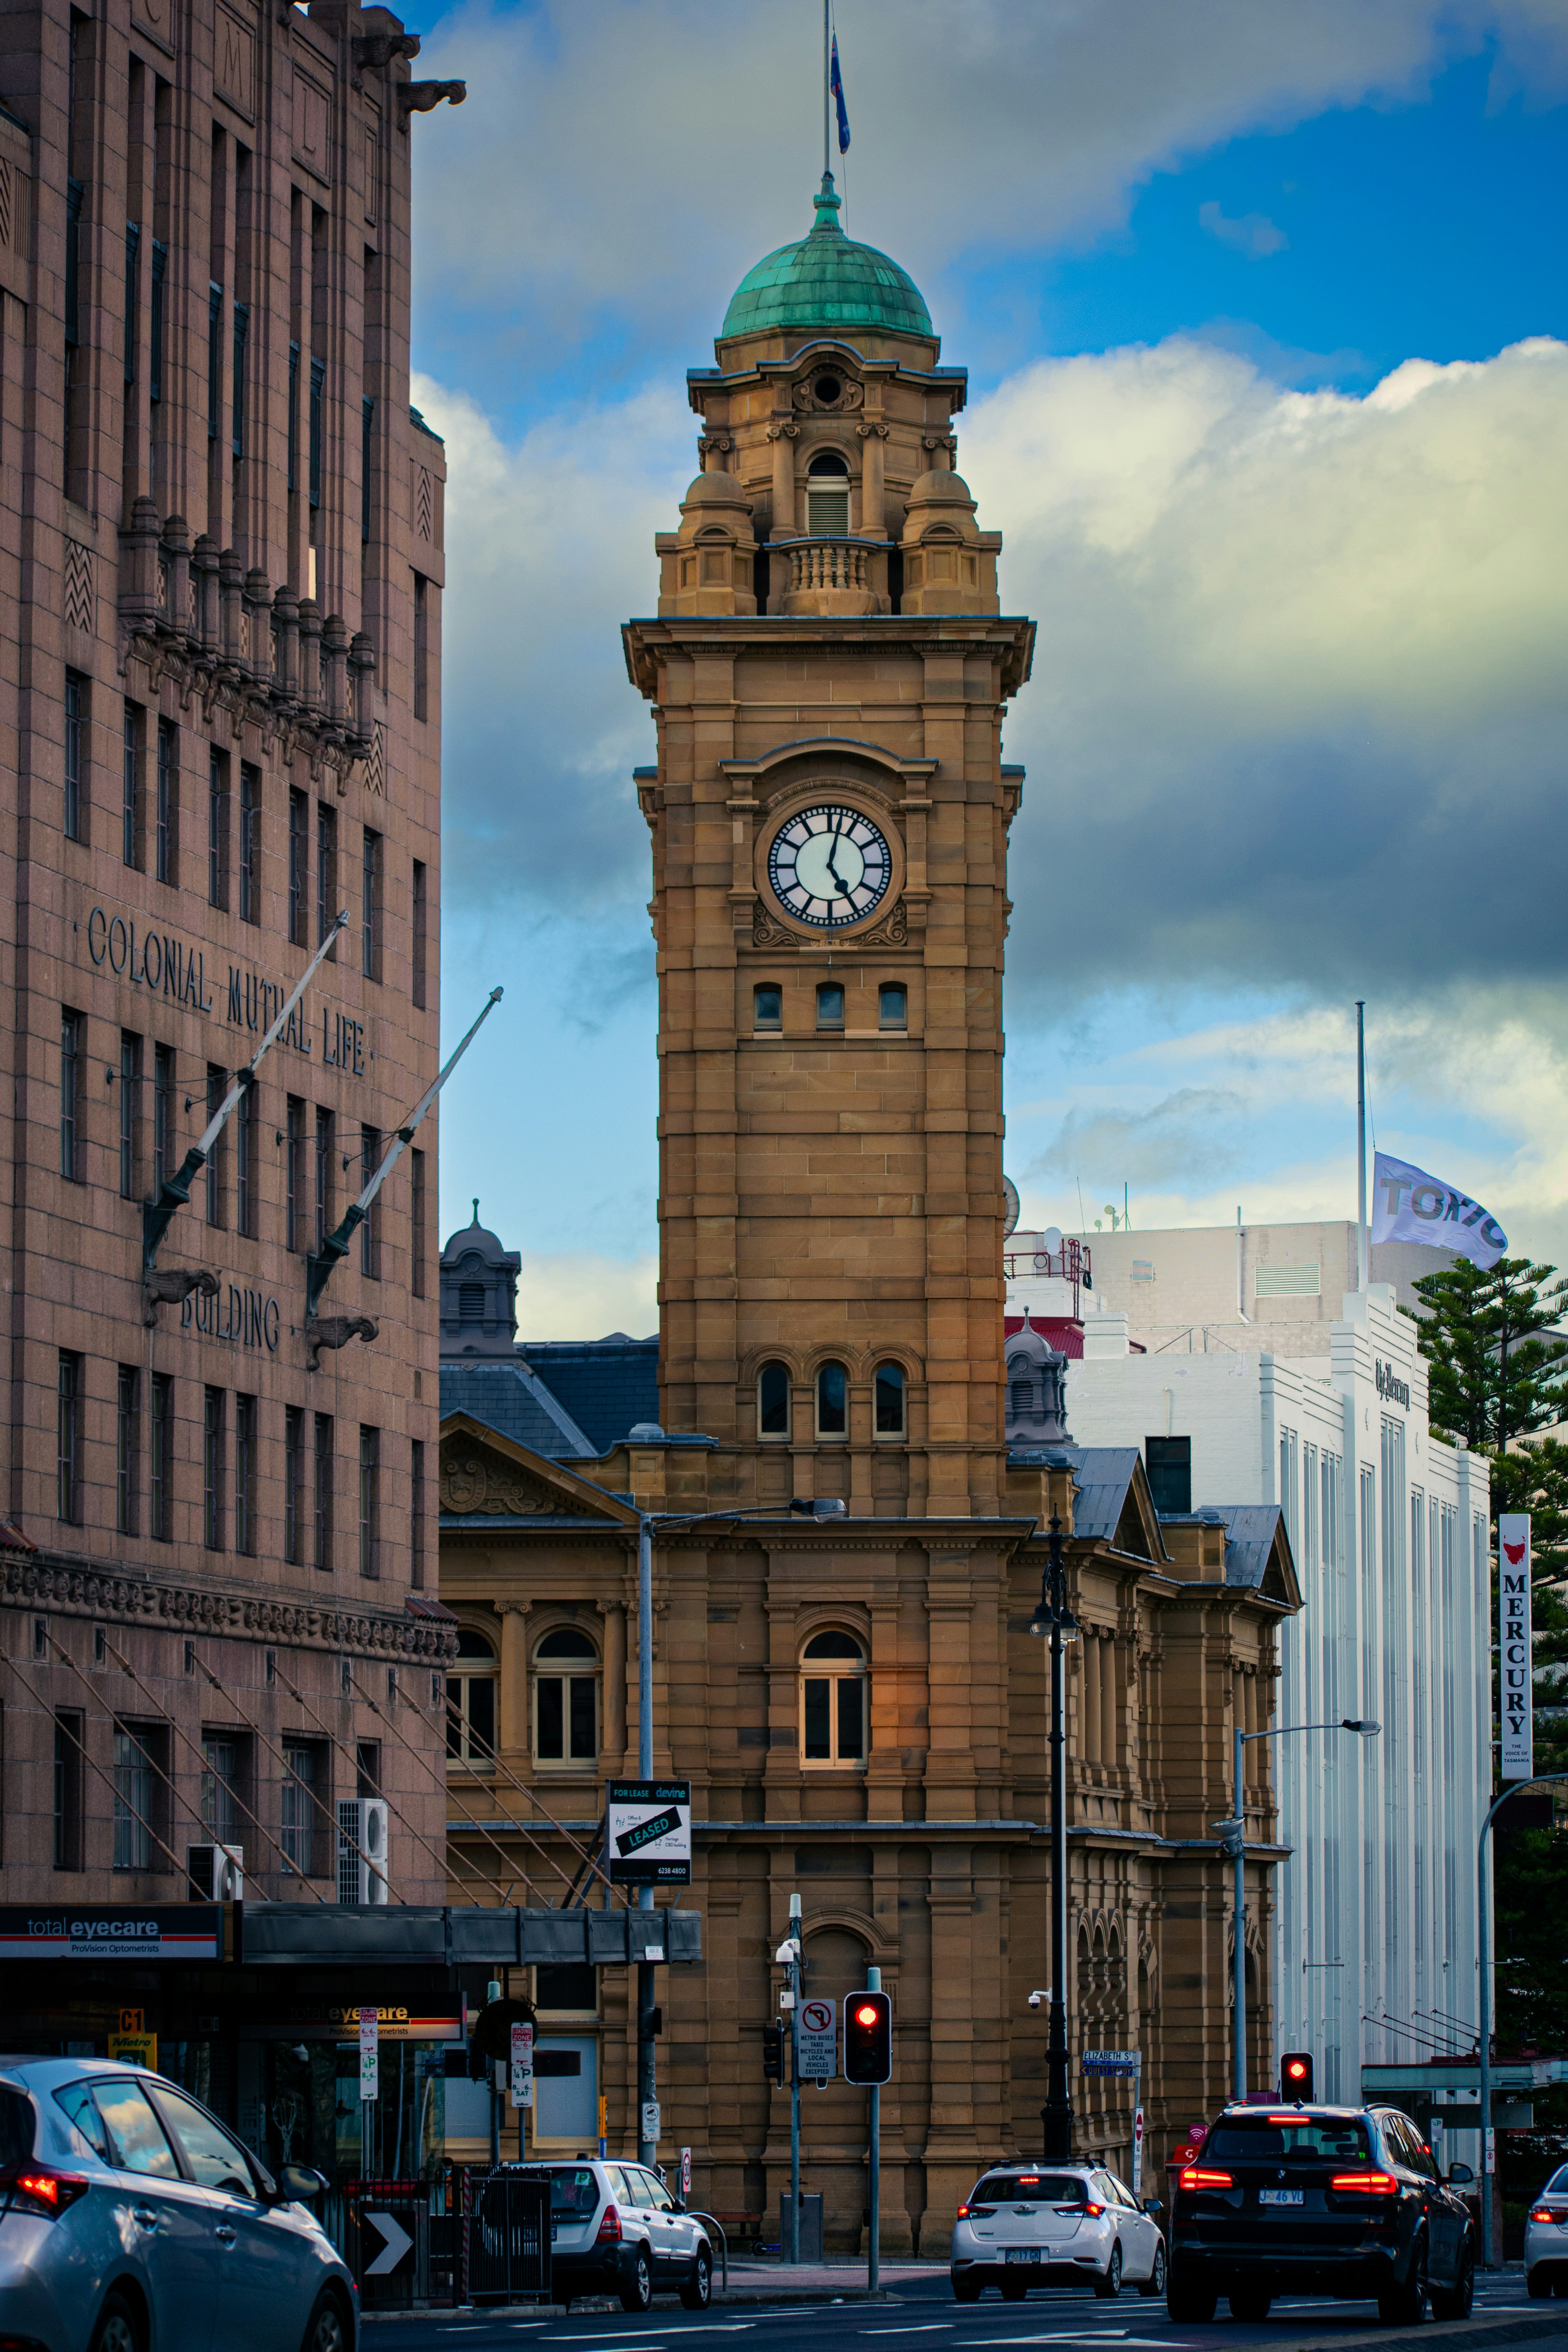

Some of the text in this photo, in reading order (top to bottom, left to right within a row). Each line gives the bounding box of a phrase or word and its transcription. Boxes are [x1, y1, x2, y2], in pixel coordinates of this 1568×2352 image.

[89, 907, 365, 1076] COLONIAL MUTUAL LIFE
[182, 1285, 279, 1351] BUILDING
[1503, 1574, 1527, 1735] MERCURY
[656, 1787, 686, 1798] devine
[629, 1818, 669, 1847] LEASED
[27, 1917, 159, 1939] total eyecare
[109, 1945, 160, 1953] Optometrists
[122, 2010, 142, 2032] C1
[290, 2005, 408, 2023] total eyeare
[112, 2038, 151, 2046] Metro
[1084, 2052, 1121, 2060] ELIZABETH
[1088, 2066, 1109, 2075] QUEST
[1275, 2191, 1288, 2202] 46
[1292, 2191, 1303, 2202] VU
[1030, 2251, 1039, 2259] GK
